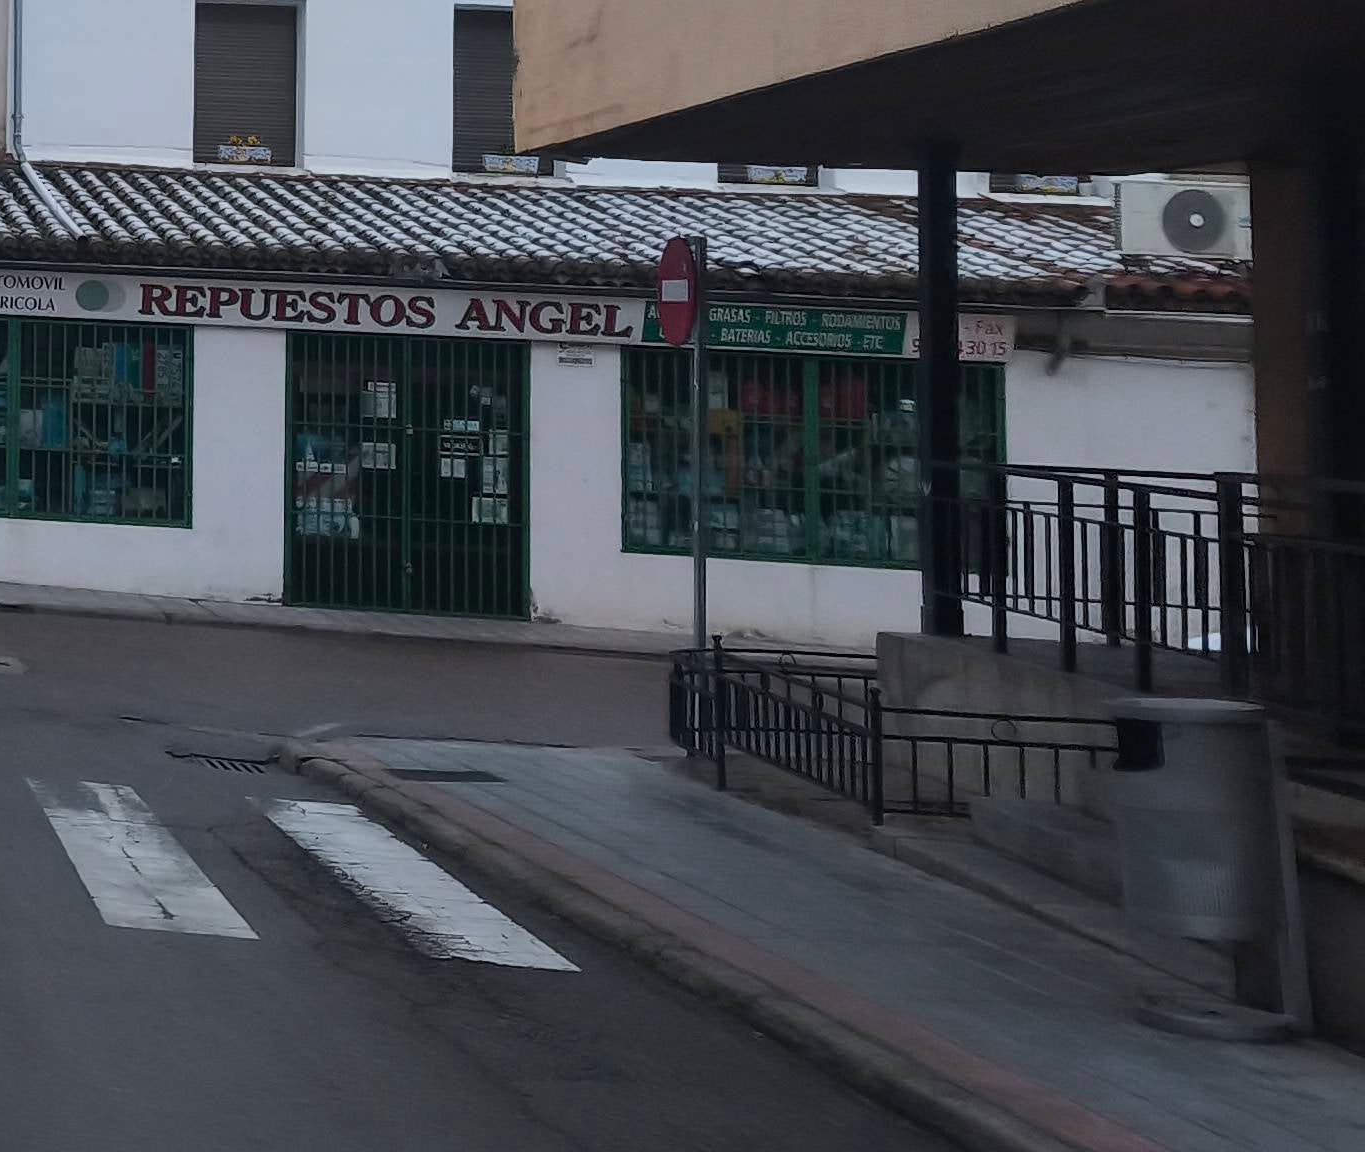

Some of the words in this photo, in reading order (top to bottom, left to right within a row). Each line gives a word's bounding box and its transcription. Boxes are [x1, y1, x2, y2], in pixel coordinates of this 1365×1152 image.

[138, 283, 436, 329] REPUESTOS
[454, 297, 635, 338] ANGEL
[709, 308, 751, 324] GRASAS
[765, 310, 808, 327] FILTROS
[821, 313, 901, 331] RODAMIENTOS
[720, 327, 771, 345] BATERIAS
[785, 330, 853, 349] ACCESORIOS
[975, 319, 1005, 336] Fax
